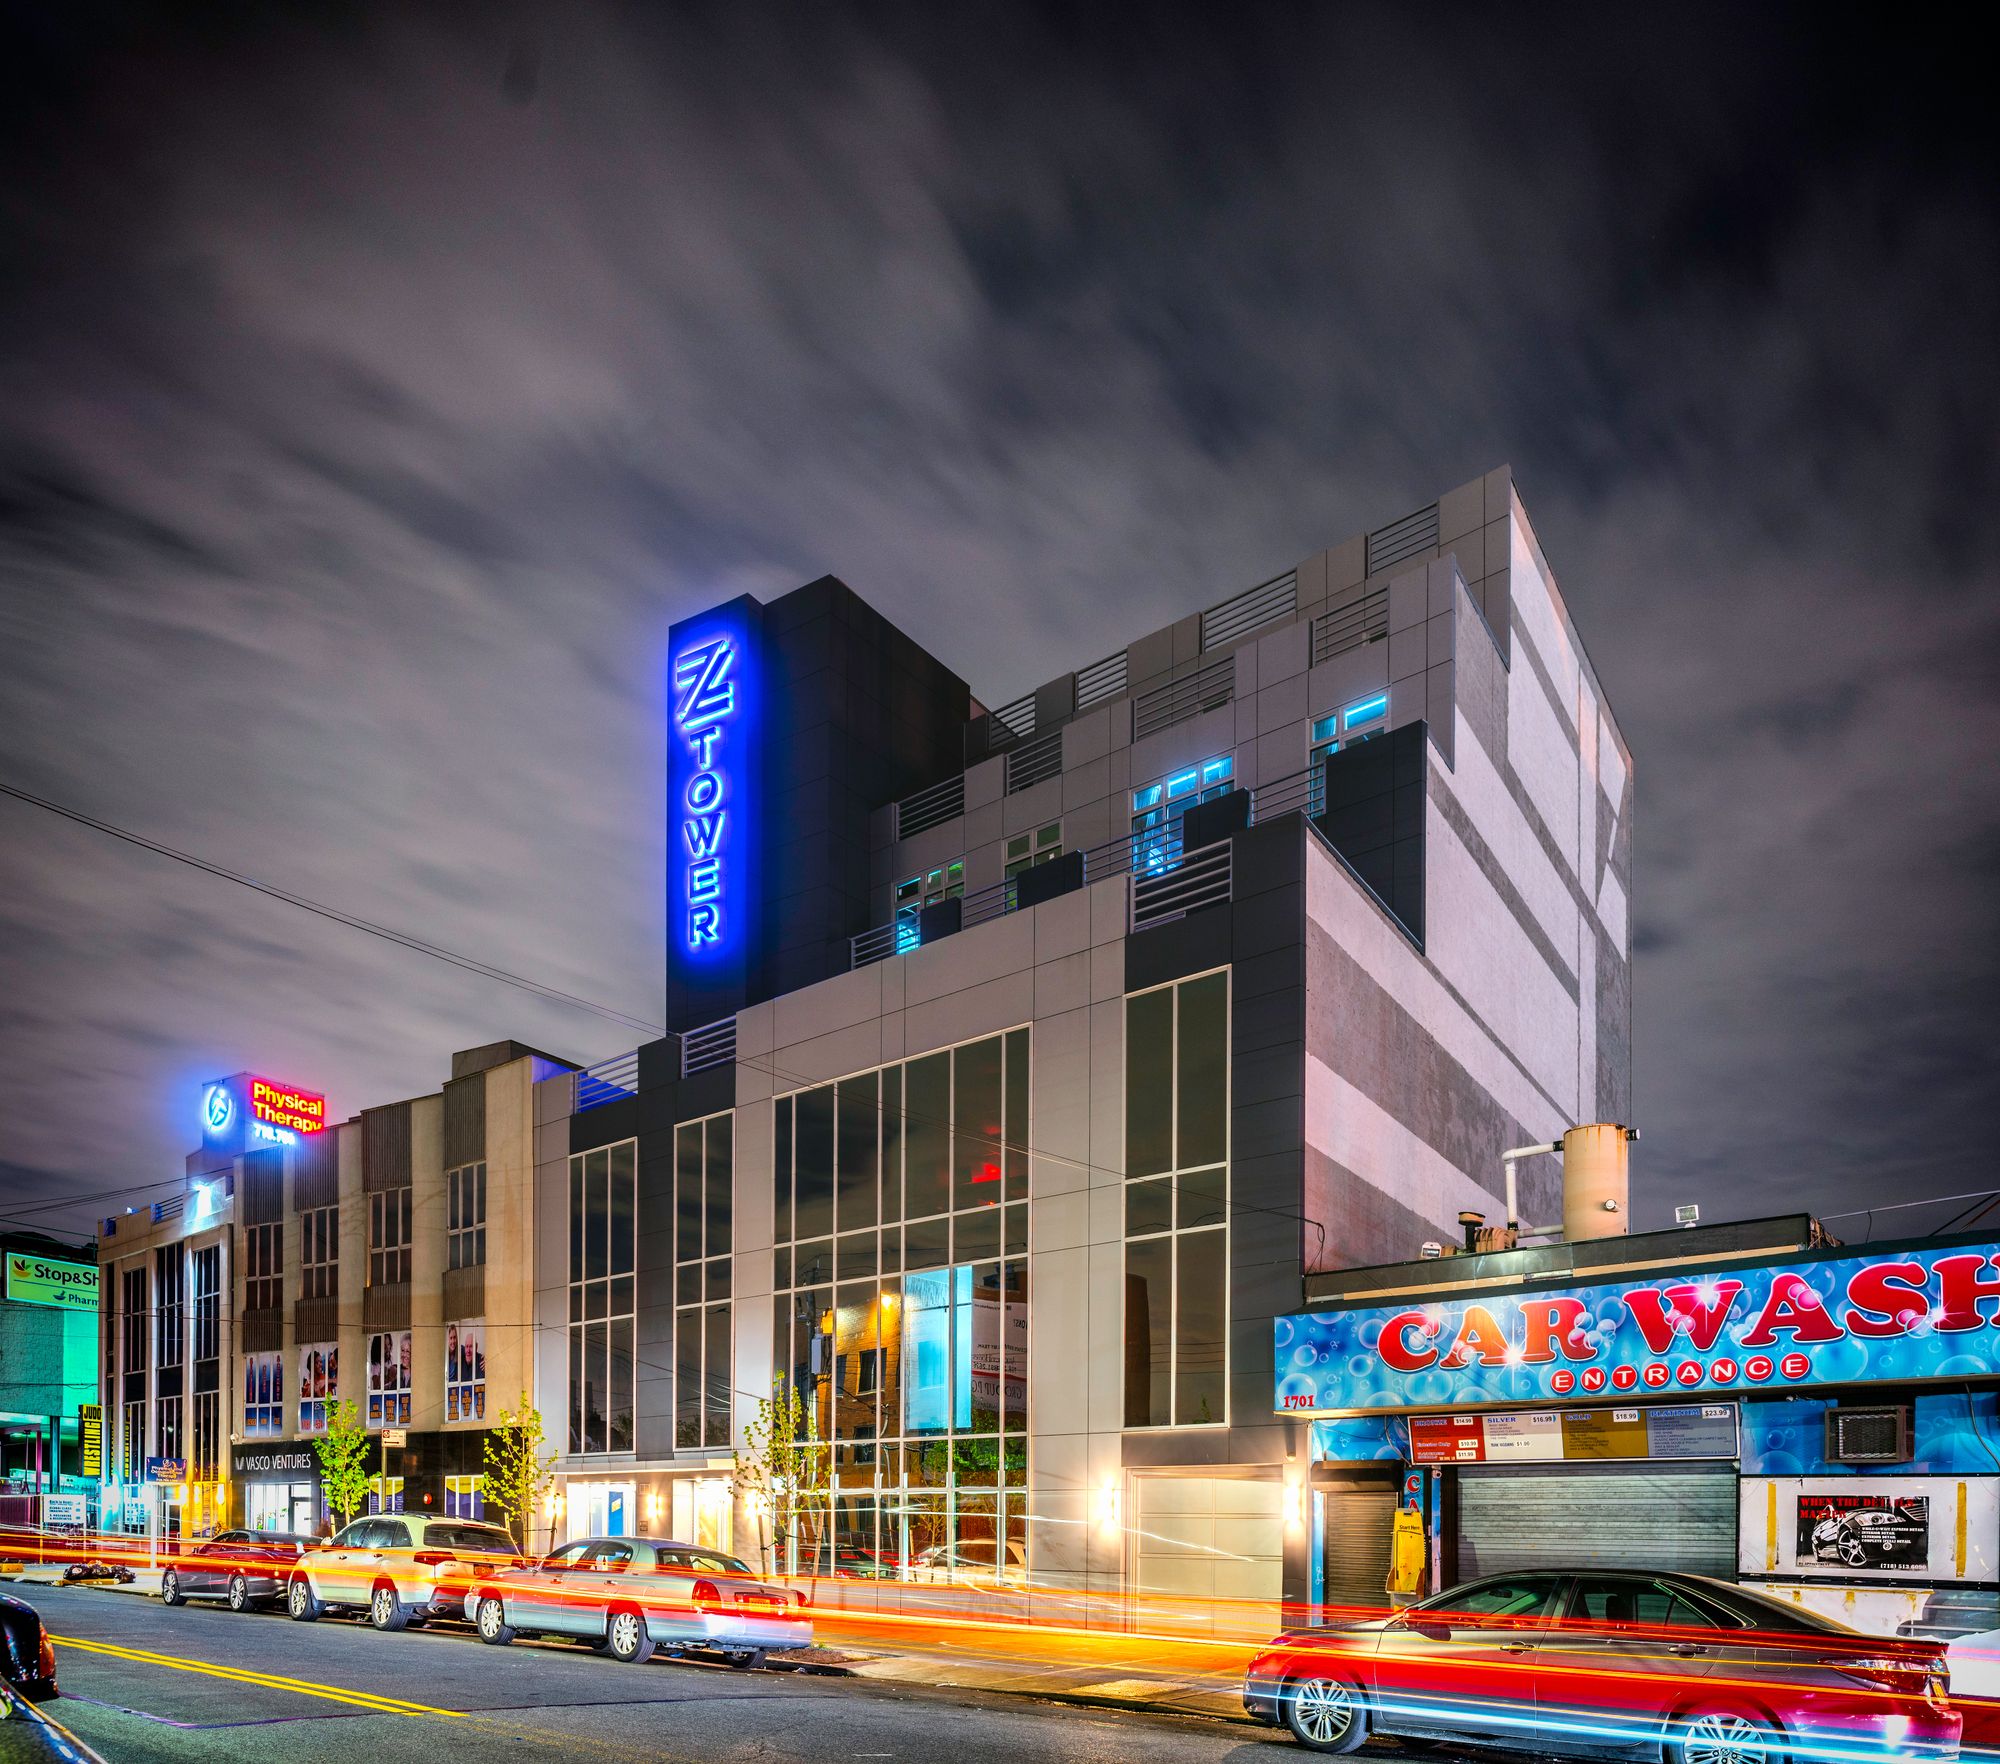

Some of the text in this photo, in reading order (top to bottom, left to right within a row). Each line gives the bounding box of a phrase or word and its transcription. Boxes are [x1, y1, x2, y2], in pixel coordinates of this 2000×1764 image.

[675, 638, 735, 946] Z TOWER
[253, 1082, 323, 1117] Physical
[1376, 1253, 2000, 1374] CAR WASH
[1554, 1356, 1805, 1391] ENTRANCE
[83, 1405, 102, 1420] JUDO
[1283, 1395, 1315, 1408] 1701
[1705, 1409, 1728, 1417] $23.99
[84, 1422, 101, 1476] WRESTLING
[246, 1453, 312, 1471] VASCO VENTURES
[1800, 1497, 1833, 1507] WHEN
[1836, 1497, 1860, 1507] THE
